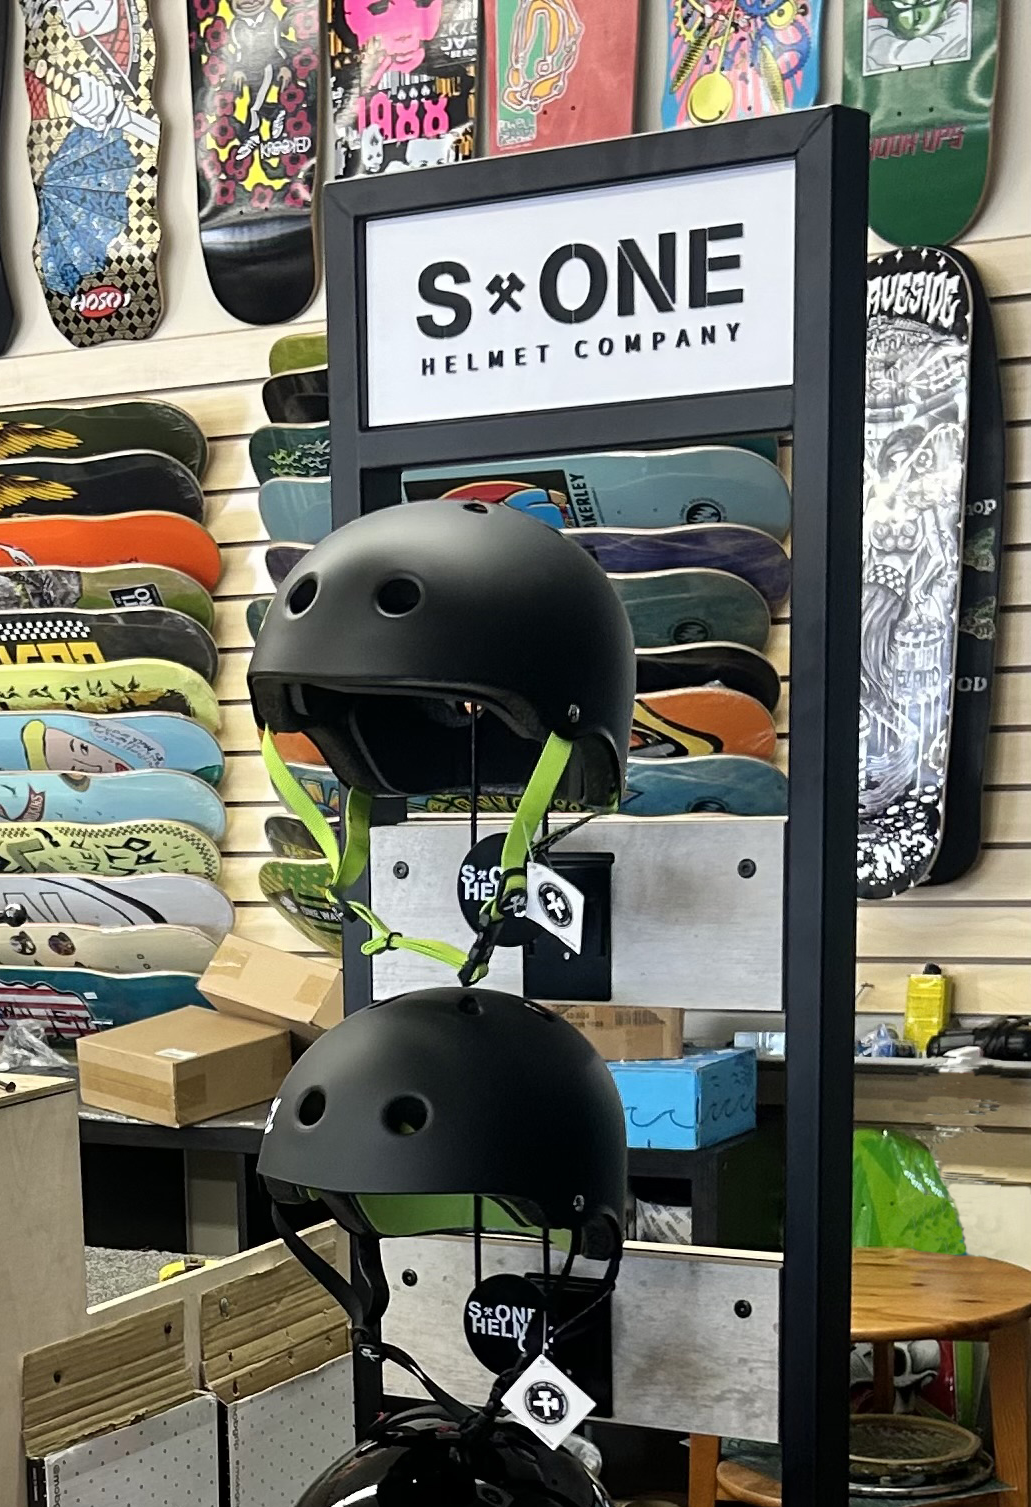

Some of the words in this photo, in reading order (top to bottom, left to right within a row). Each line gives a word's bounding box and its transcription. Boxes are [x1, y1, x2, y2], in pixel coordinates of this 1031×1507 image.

[420, 344, 550, 377] HELMET
[574, 322, 741, 359] COMPANY
[570, 472, 596, 528] AKERLEY
